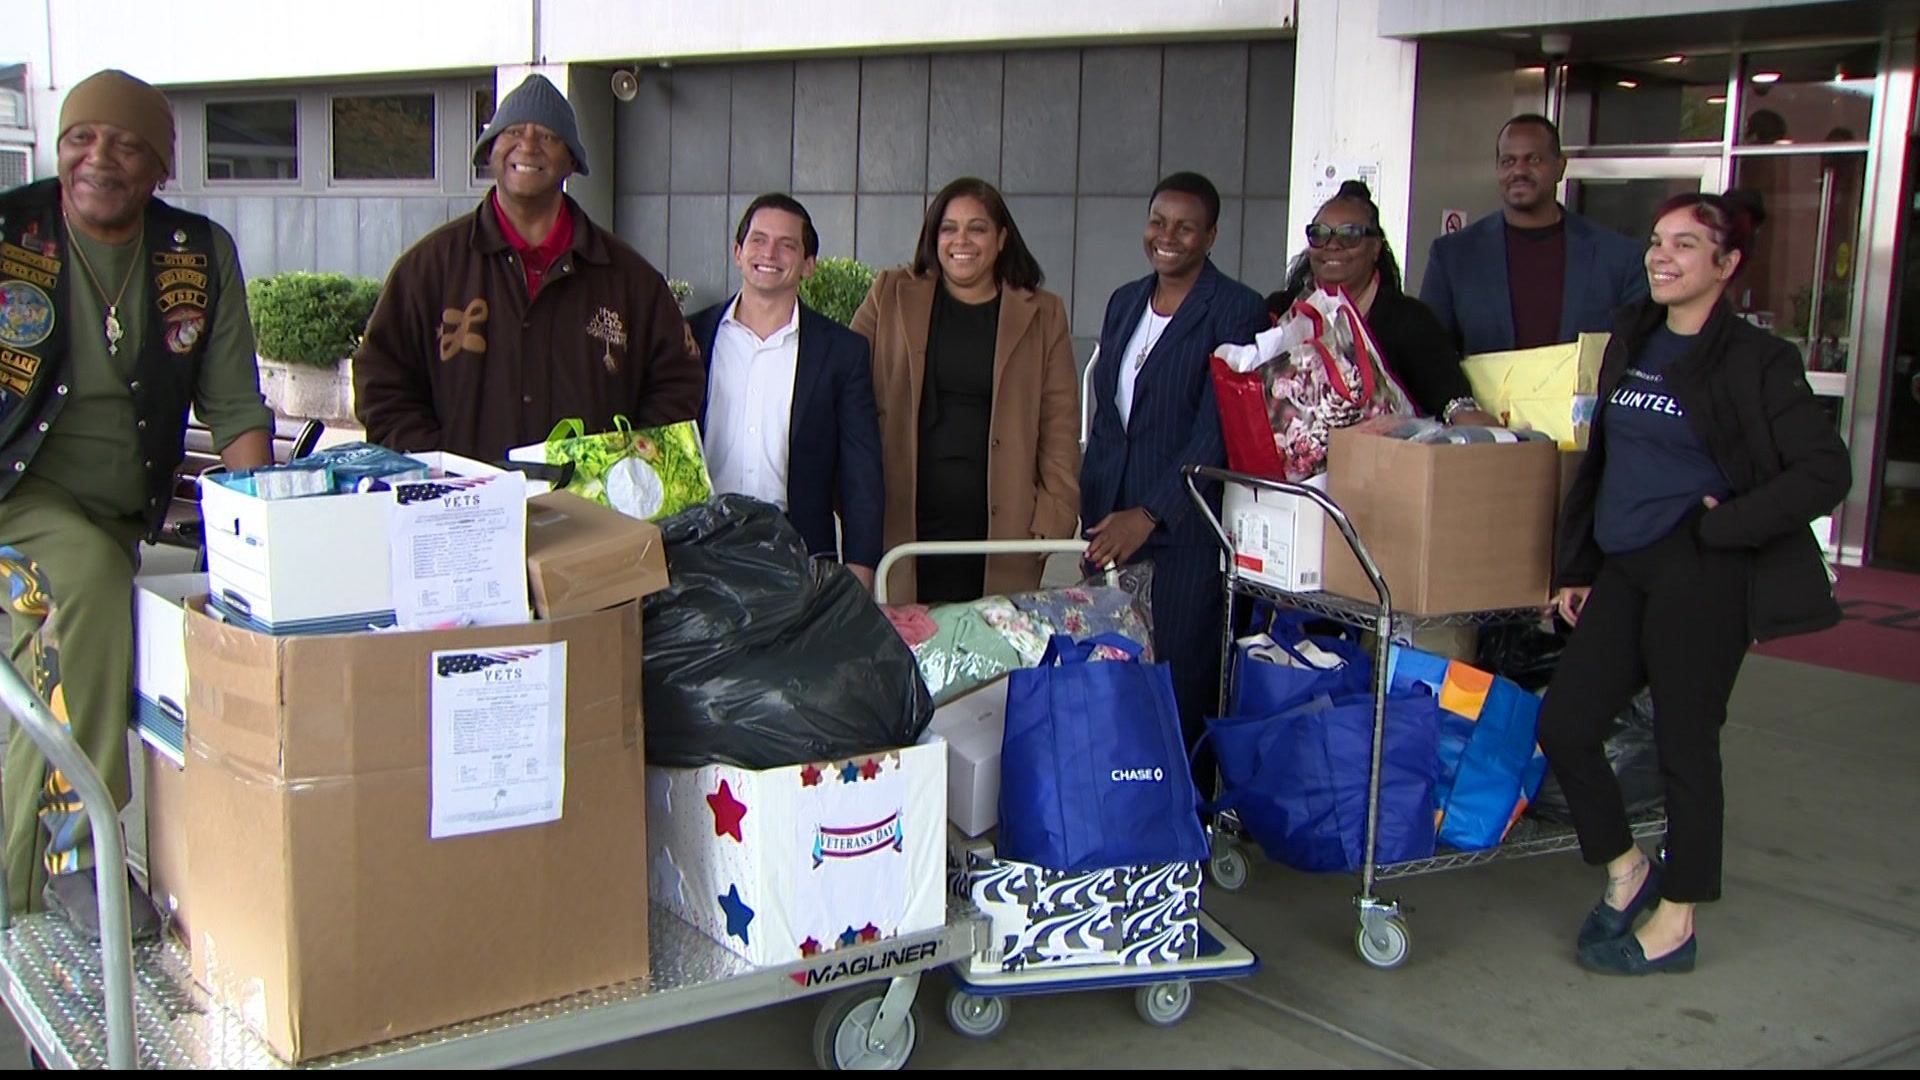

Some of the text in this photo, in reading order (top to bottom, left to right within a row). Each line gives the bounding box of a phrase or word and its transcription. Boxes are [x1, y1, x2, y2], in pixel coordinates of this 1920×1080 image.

[1610, 388, 1684, 417] LUNTEE
[443, 494, 480, 508] VETS
[484, 667, 522, 681] VETS
[1111, 769, 1153, 781] CHASE
[820, 823, 895, 850] VETERANS DAY
[805, 940, 938, 987] MAGLINER
